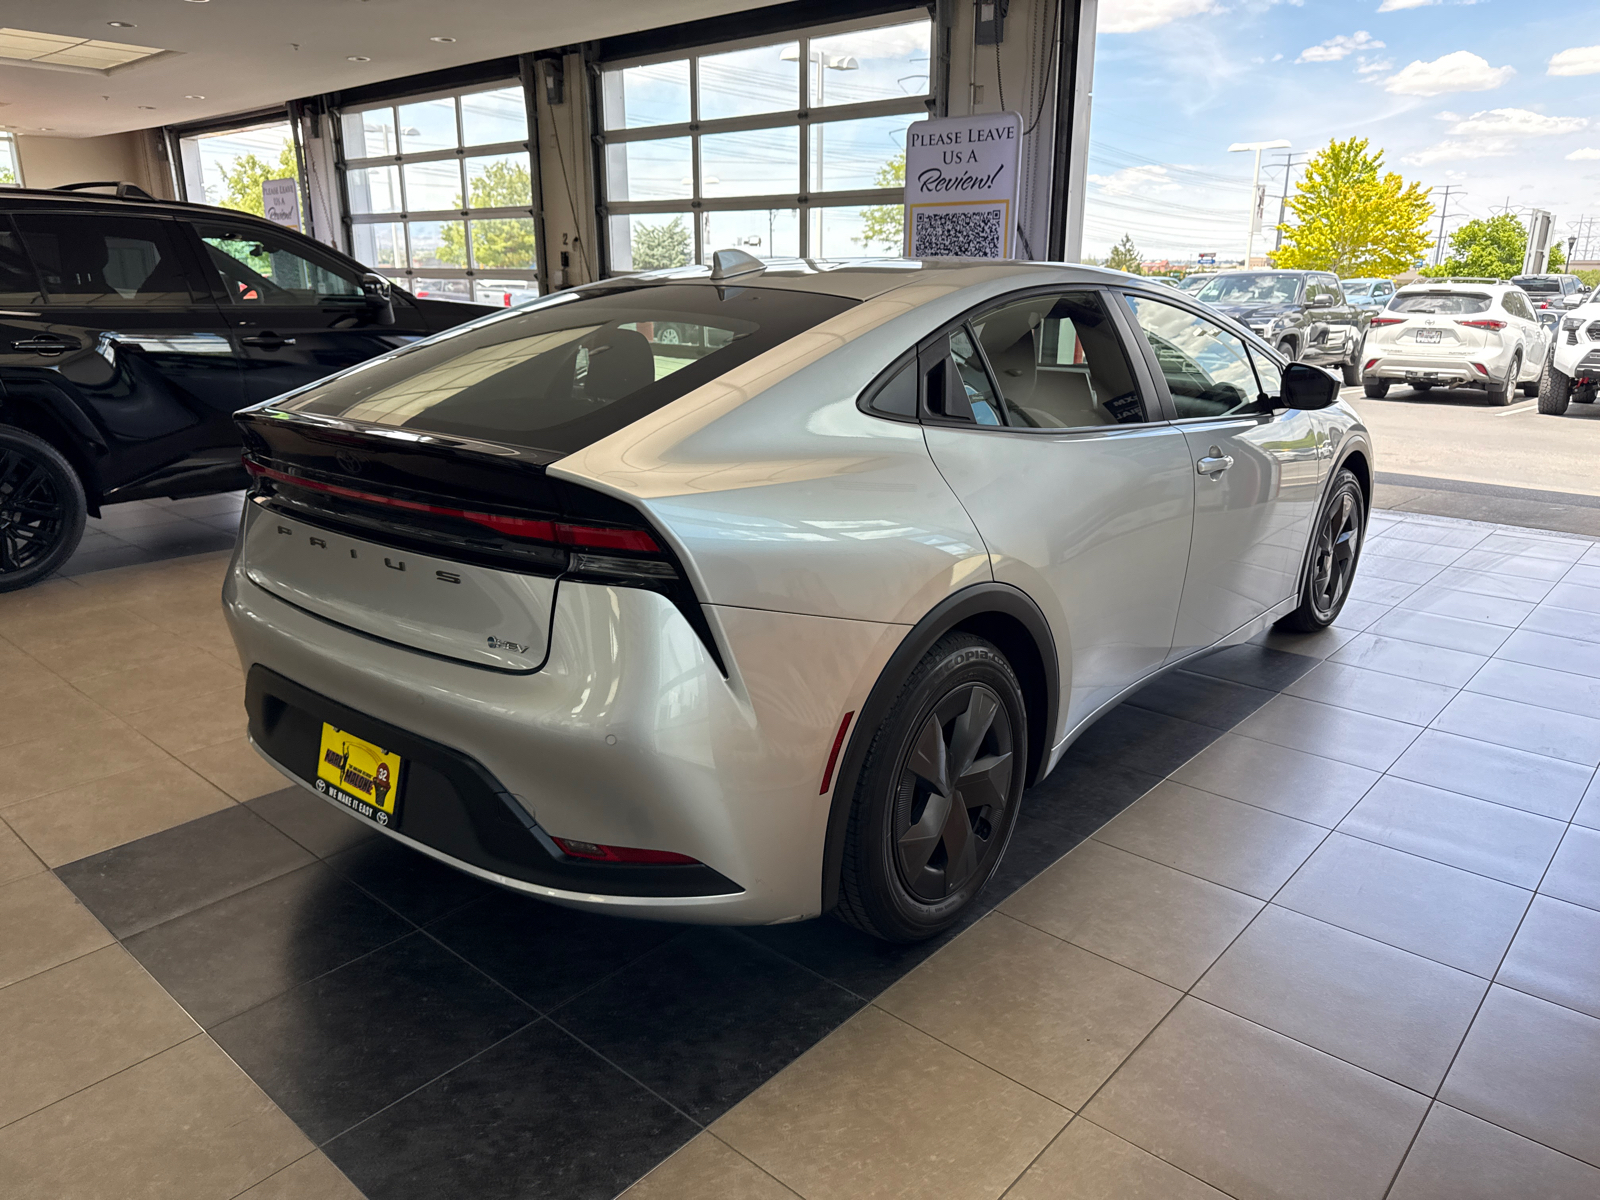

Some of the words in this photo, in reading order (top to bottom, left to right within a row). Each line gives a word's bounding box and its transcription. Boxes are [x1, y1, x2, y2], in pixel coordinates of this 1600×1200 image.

[911, 131, 962, 148] PLEASE
[967, 126, 1015, 143] LEAVE
[942, 150, 963, 165] US
[966, 149, 979, 164] A
[917, 163, 1005, 193] Review!
[562, 233, 568, 245] 2
[277, 525, 461, 584] PRIUS
[378, 768, 388, 782] 32
[328, 786, 337, 798] WE
[337, 791, 352, 807] MAKE
[352, 799, 358, 810] IT
[359, 802, 373, 818] EASY
